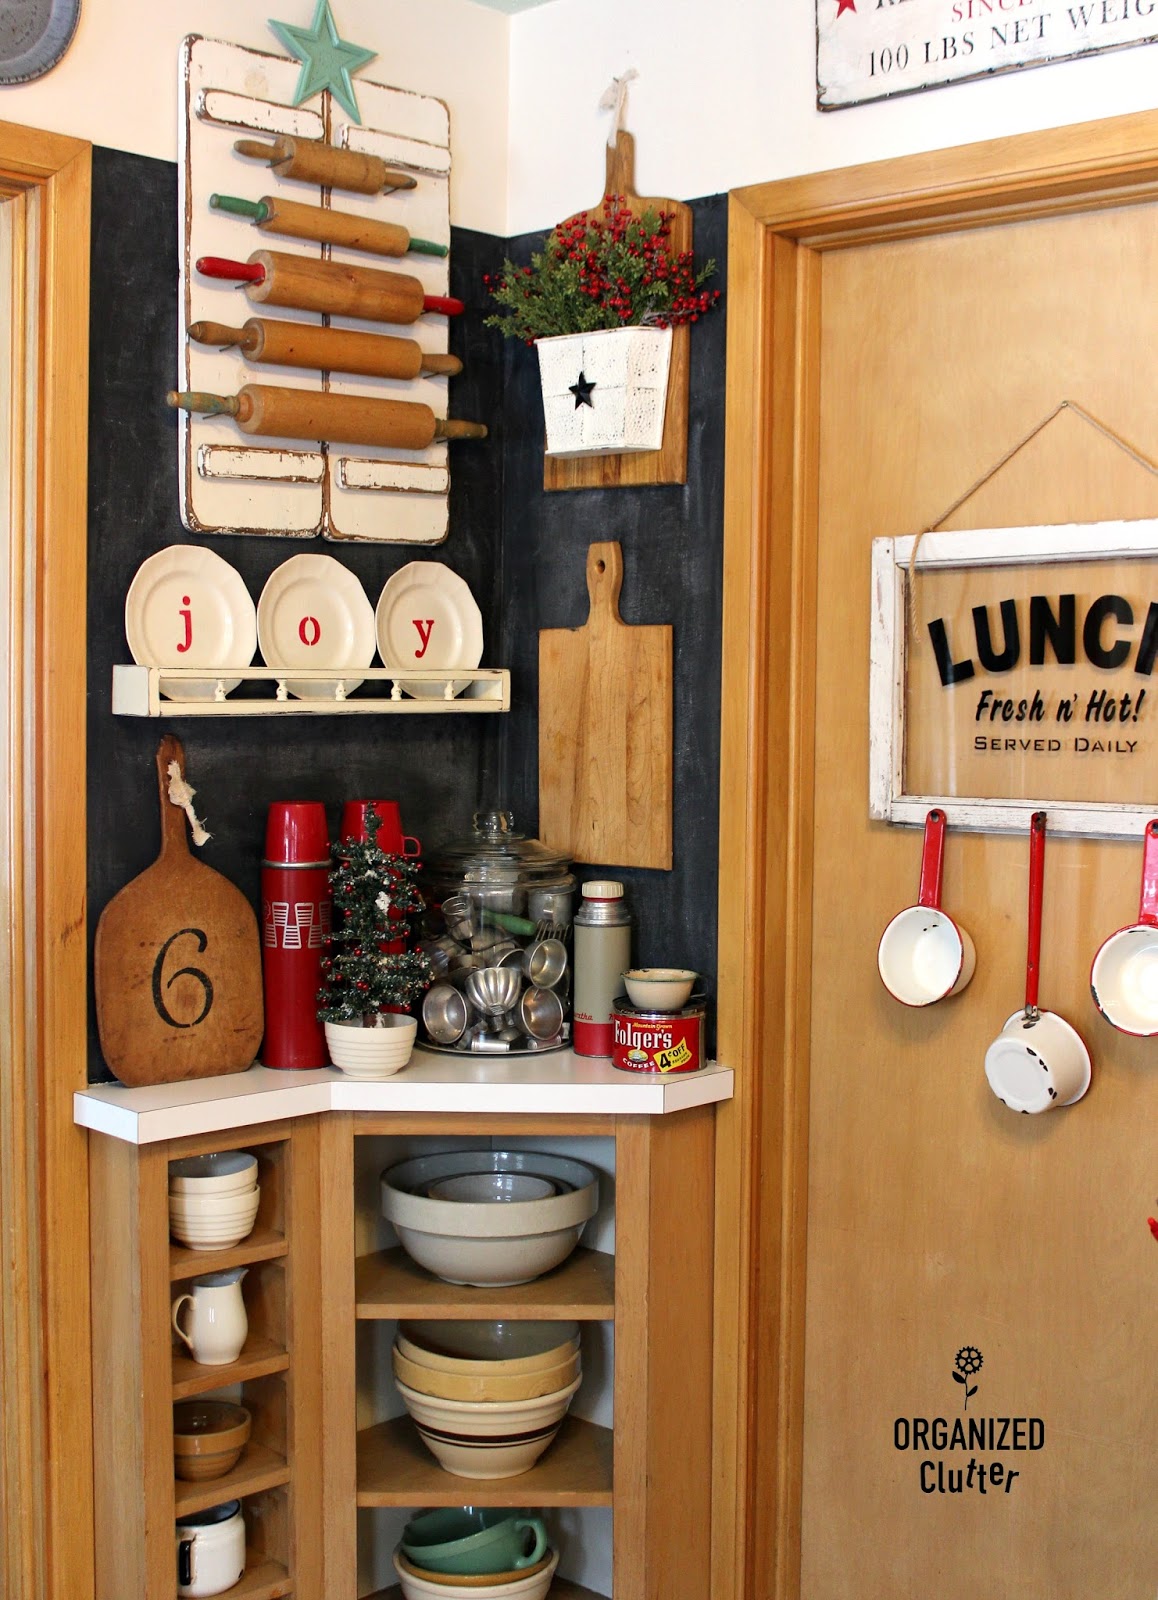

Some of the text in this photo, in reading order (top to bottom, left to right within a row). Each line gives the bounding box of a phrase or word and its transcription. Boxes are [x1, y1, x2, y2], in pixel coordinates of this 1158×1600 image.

[868, 44, 909, 77] 100
[924, 31, 974, 65] LBS
[990, 13, 1053, 49] NET
[975, 690, 1045, 722] Fresh
[1085, 689, 1146, 723] Hot!
[974, 736, 1138, 753] SERVED DAILY
[152, 927, 214, 1029] 6
[615, 1020, 672, 1050] Folger's
[622, 1058, 655, 1069] COFFEE
